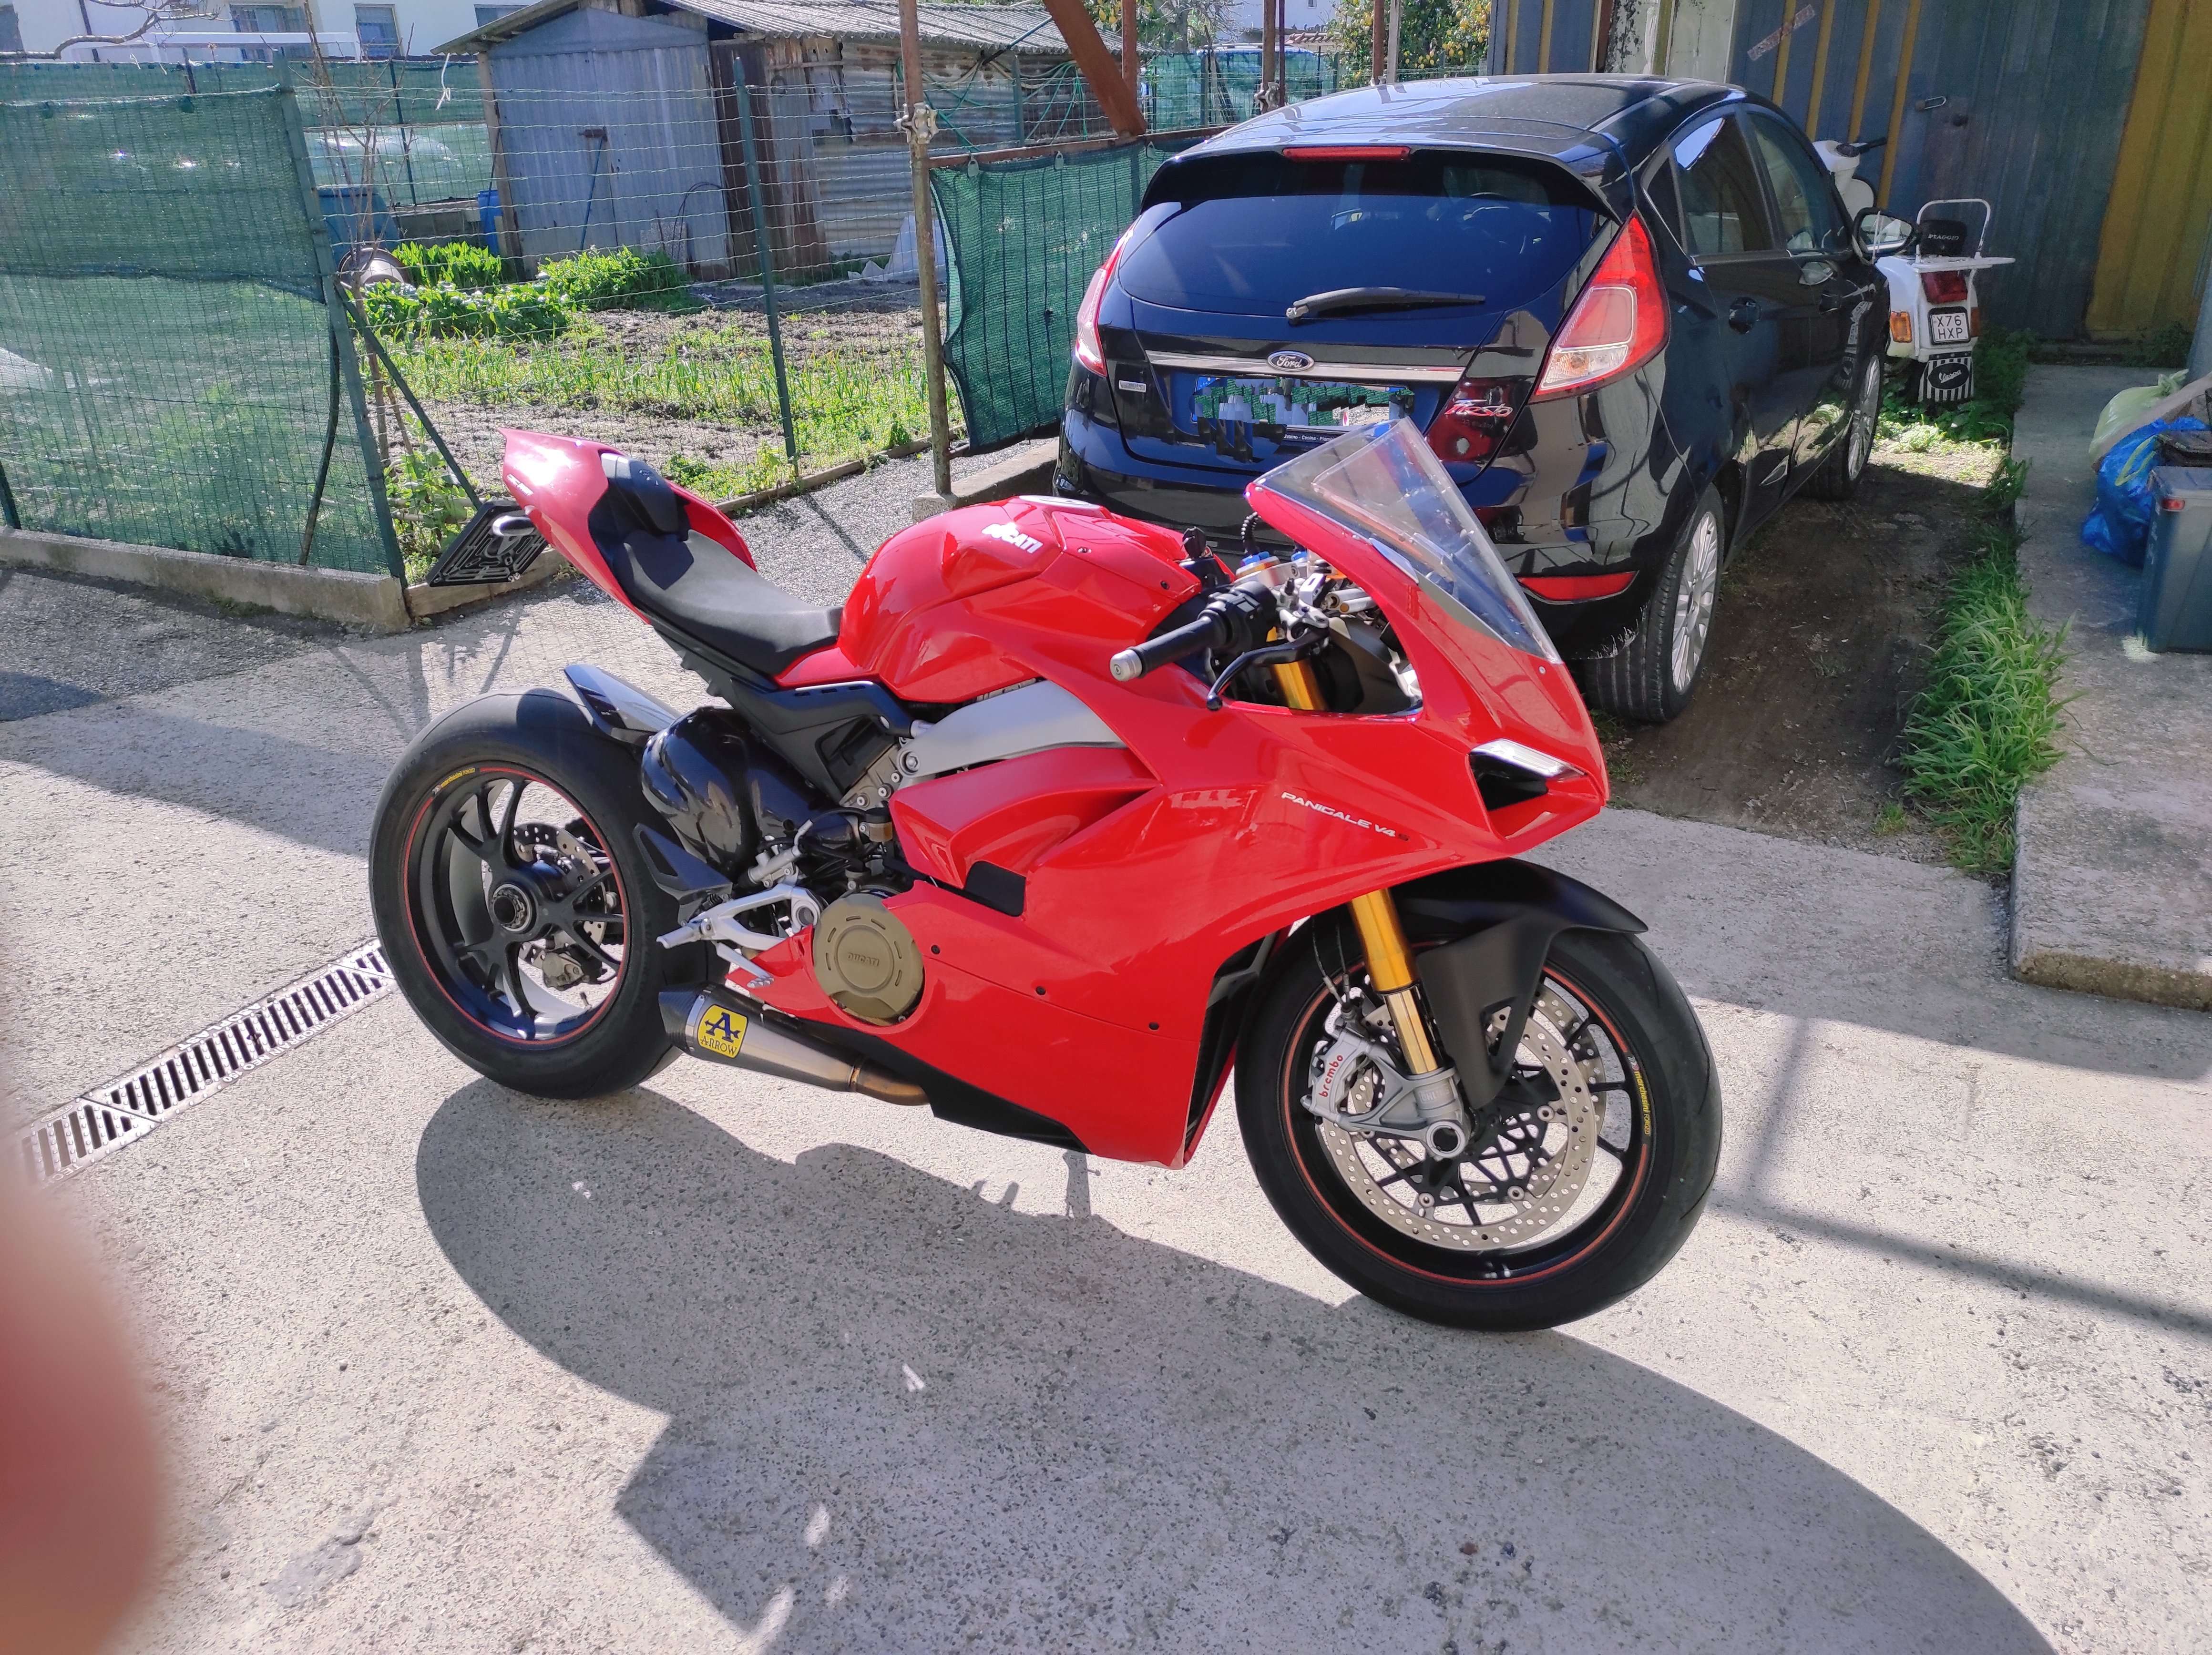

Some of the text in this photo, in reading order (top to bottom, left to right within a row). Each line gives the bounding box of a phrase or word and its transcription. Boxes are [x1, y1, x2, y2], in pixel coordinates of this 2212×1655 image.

[1937, 316, 1962, 327] X76
[1938, 327, 1963, 339] HXP
[1276, 355, 1302, 368] Ford
[1281, 791, 1396, 837] PANIGALE V4
[847, 952, 880, 967] DUCATI
[700, 1035, 737, 1056] ARROW
[1319, 1054, 1343, 1097] brembo
[1634, 1071, 1651, 1114] marchesini
